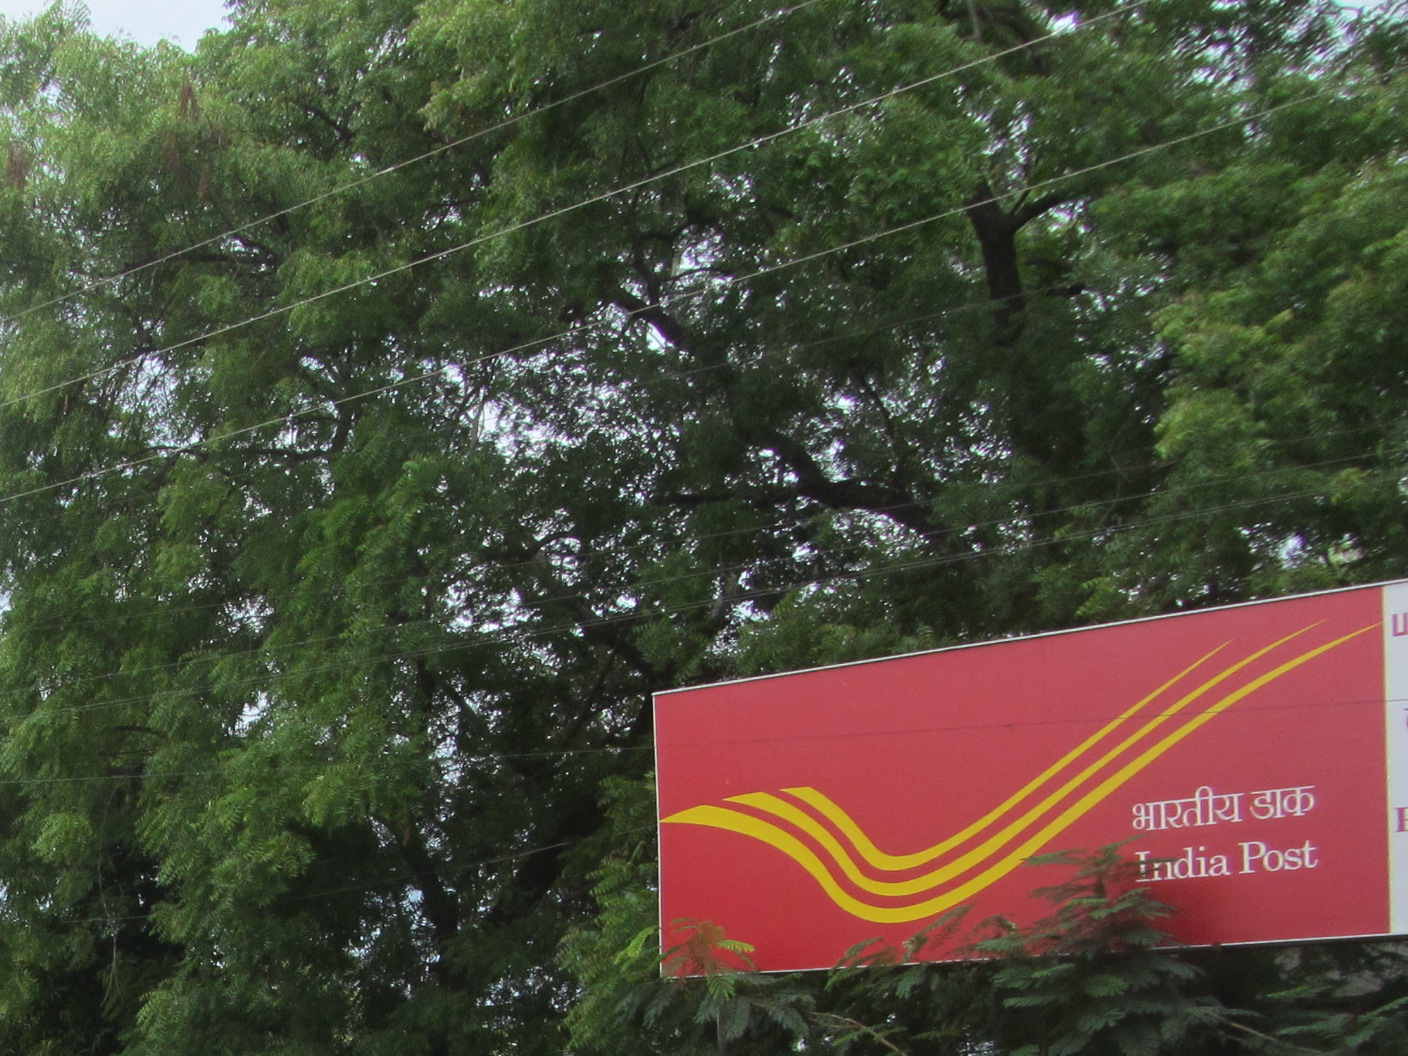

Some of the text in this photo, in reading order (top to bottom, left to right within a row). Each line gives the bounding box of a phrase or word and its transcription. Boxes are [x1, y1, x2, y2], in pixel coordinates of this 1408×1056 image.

[1132, 785, 1316, 831] भारतीय डाक
[1135, 839, 1319, 883] India Post
